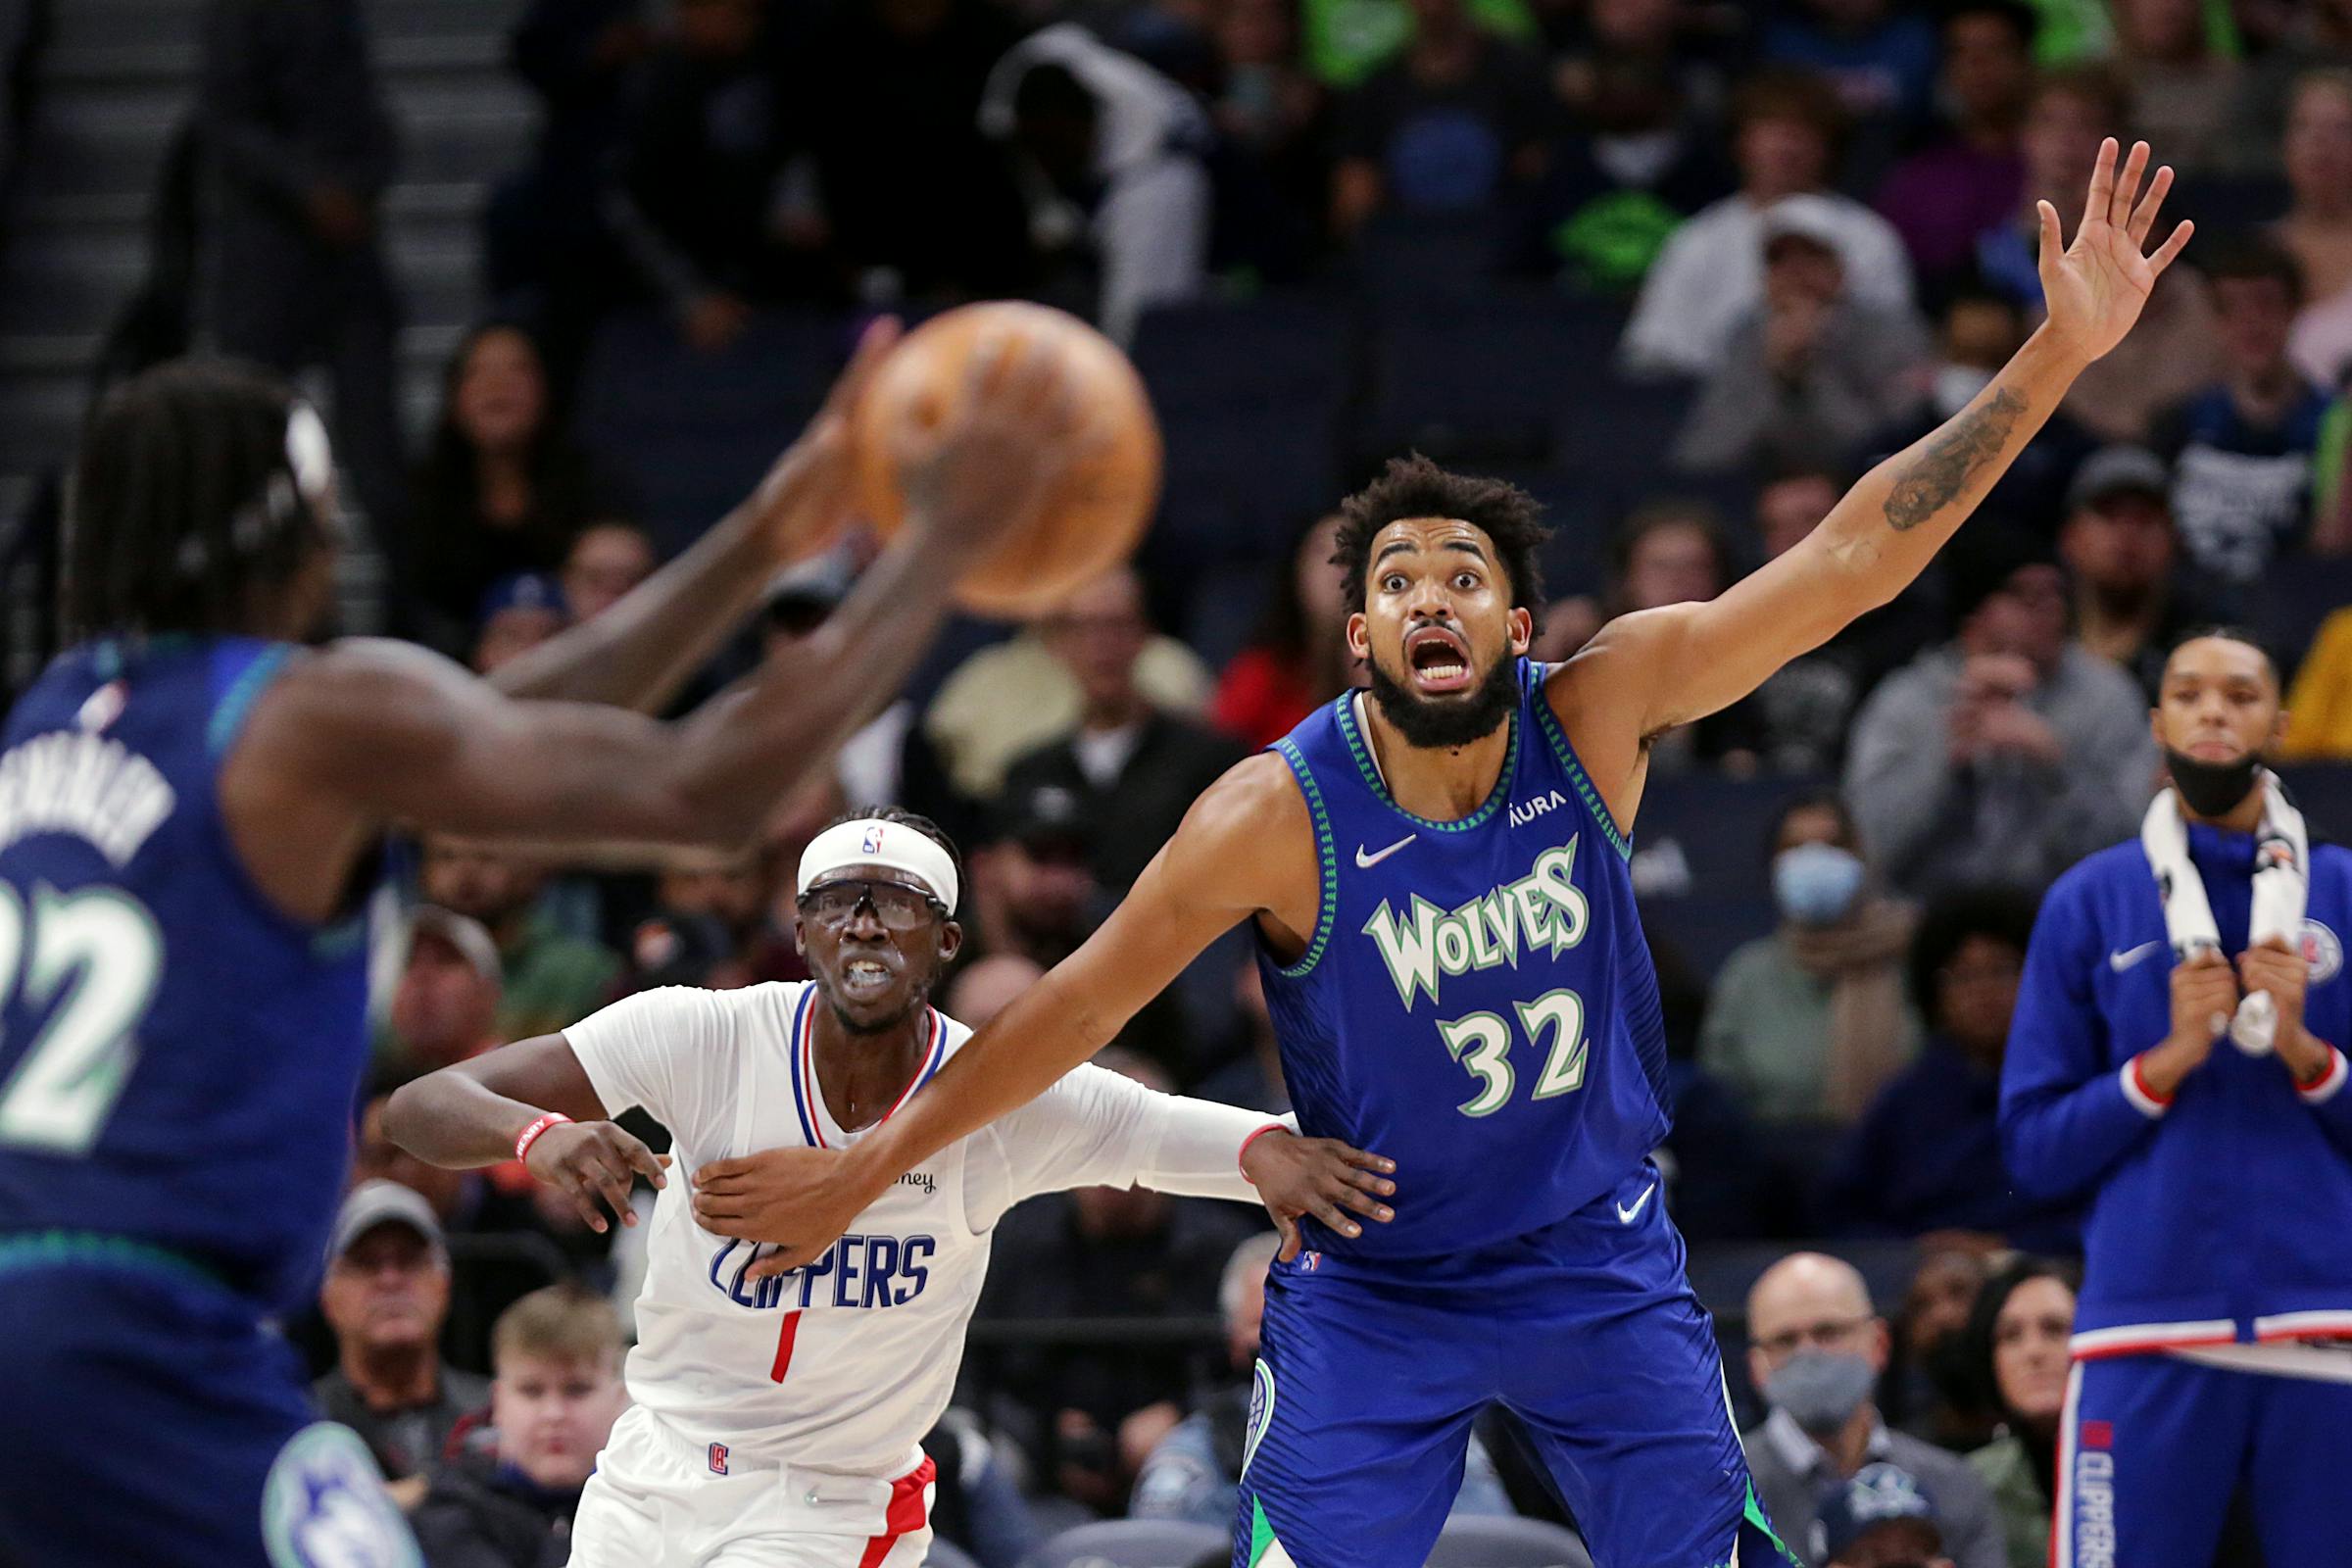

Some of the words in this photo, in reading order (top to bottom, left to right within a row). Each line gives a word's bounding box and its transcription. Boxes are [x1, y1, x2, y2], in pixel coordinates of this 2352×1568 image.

[1509, 790, 1567, 829] AURA
[1361, 831, 1590, 1013] WOLVES
[0, 879, 165, 1154] 2
[1435, 988, 1590, 1117] 32
[894, 1172, 937, 1195] ney
[769, 1308, 804, 1385] 1
